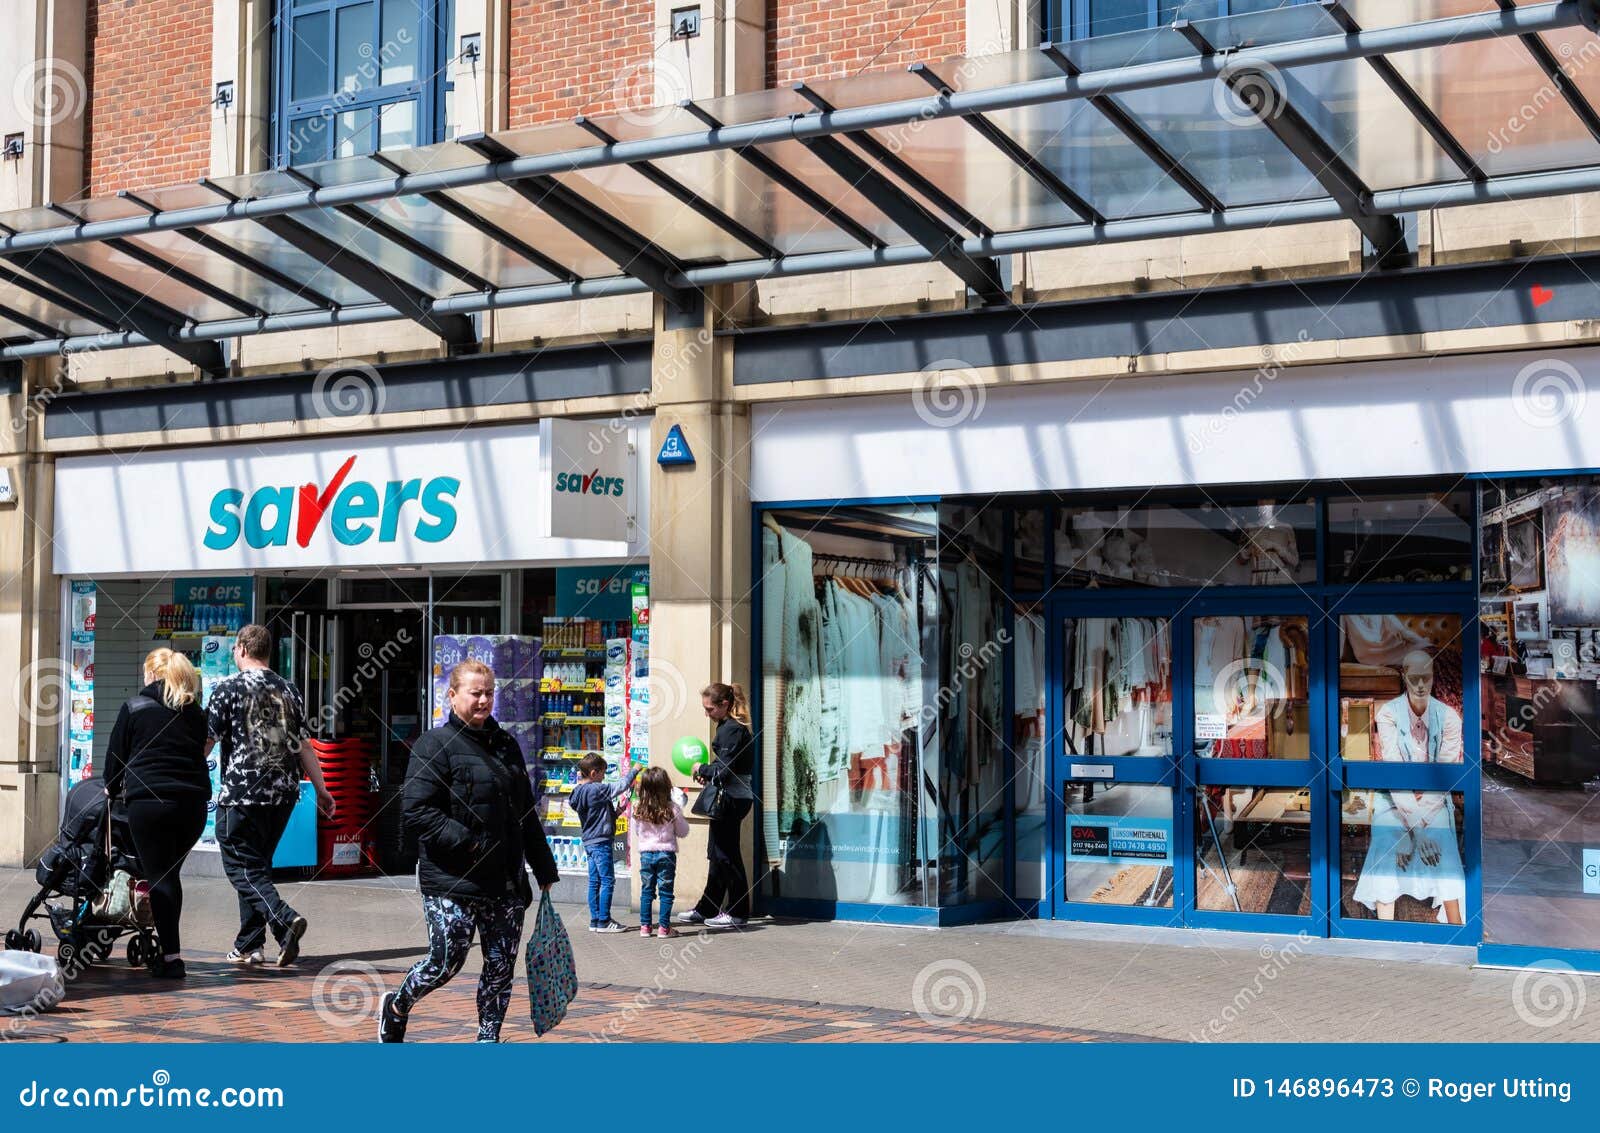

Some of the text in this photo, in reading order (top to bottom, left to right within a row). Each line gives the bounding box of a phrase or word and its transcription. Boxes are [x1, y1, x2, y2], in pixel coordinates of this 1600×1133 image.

[555, 468, 625, 497] savers
[203, 454, 461, 551] savers
[189, 584, 241, 601] savers
[576, 577, 632, 595] saver
[434, 647, 462, 665] Soft
[1073, 828, 1096, 840] GVA
[1113, 841, 1127, 850] 020
